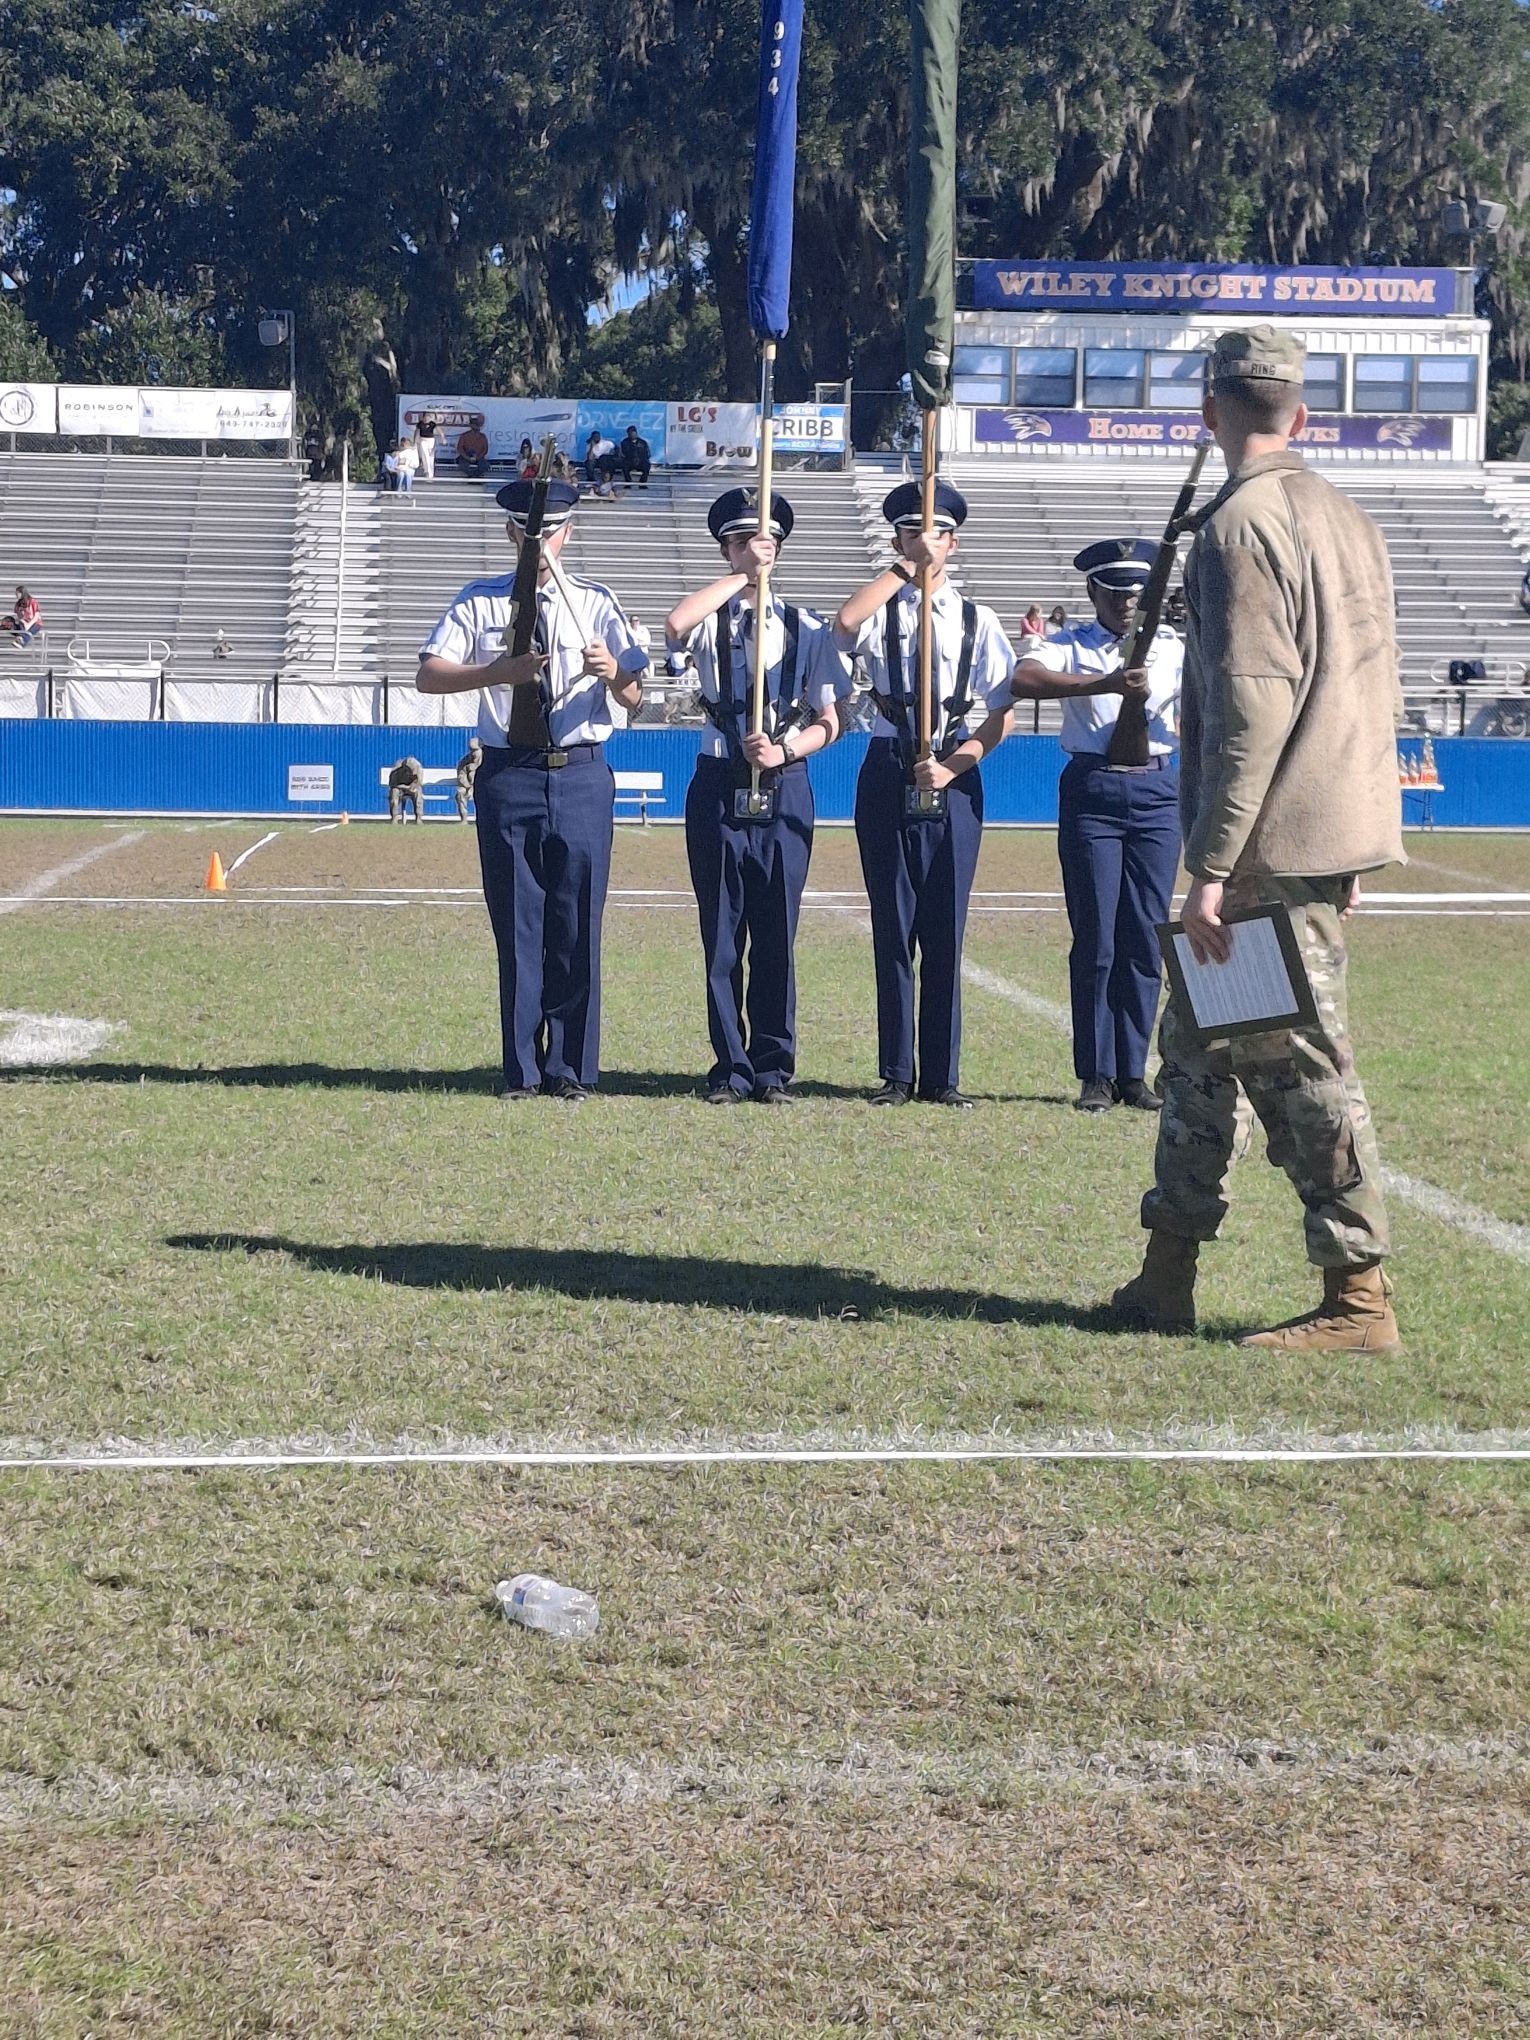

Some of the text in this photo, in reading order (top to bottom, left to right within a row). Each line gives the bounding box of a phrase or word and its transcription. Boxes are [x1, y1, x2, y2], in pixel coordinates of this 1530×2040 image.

[767, 20, 785, 96] 934
[996, 271, 1437, 303] WILEY KNIGHT STADIUM
[1251, 363, 1277, 376] RING
[64, 403, 133, 412] ROBINSON
[1087, 417, 1165, 441] HOME
[1169, 425, 1201, 441] OF
